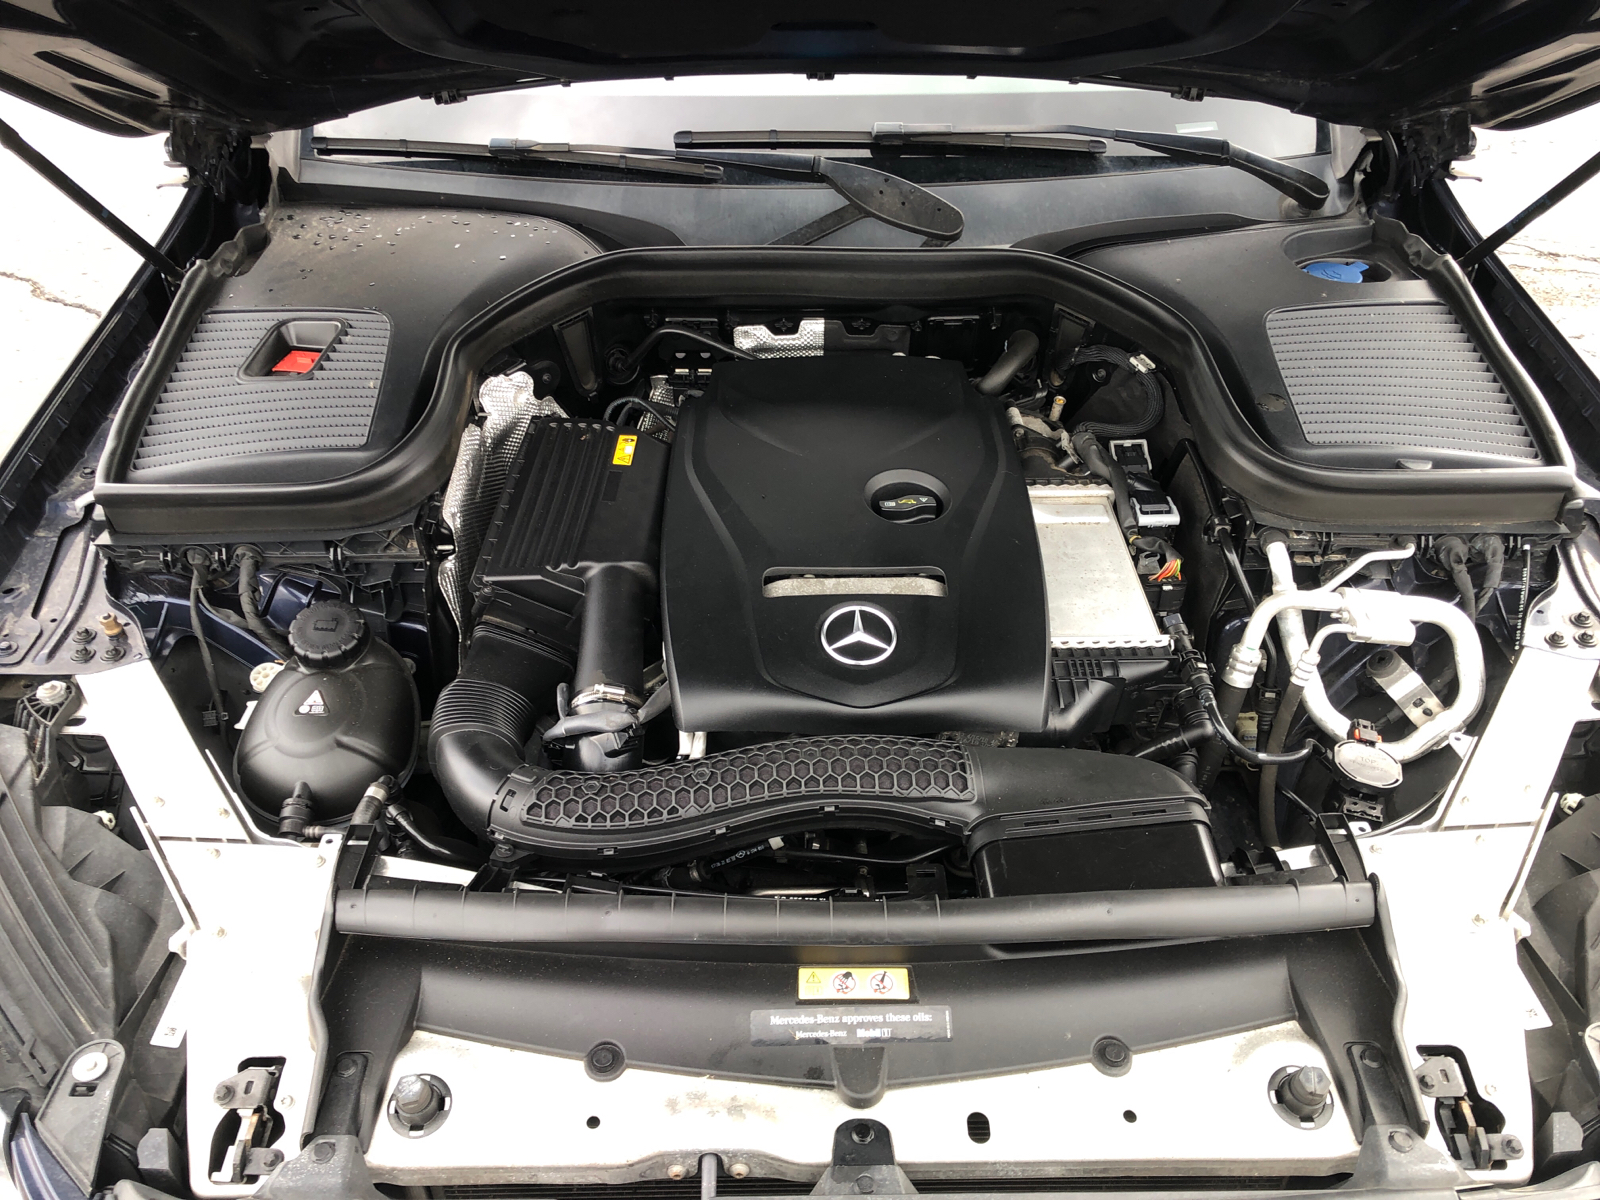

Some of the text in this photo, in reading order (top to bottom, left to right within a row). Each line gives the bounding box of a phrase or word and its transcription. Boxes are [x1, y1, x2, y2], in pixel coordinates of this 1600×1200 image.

[770, 1011, 933, 1025] Mercedes-Benz approves these oils:
[795, 1029, 847, 1039] Mercedes-Benz
